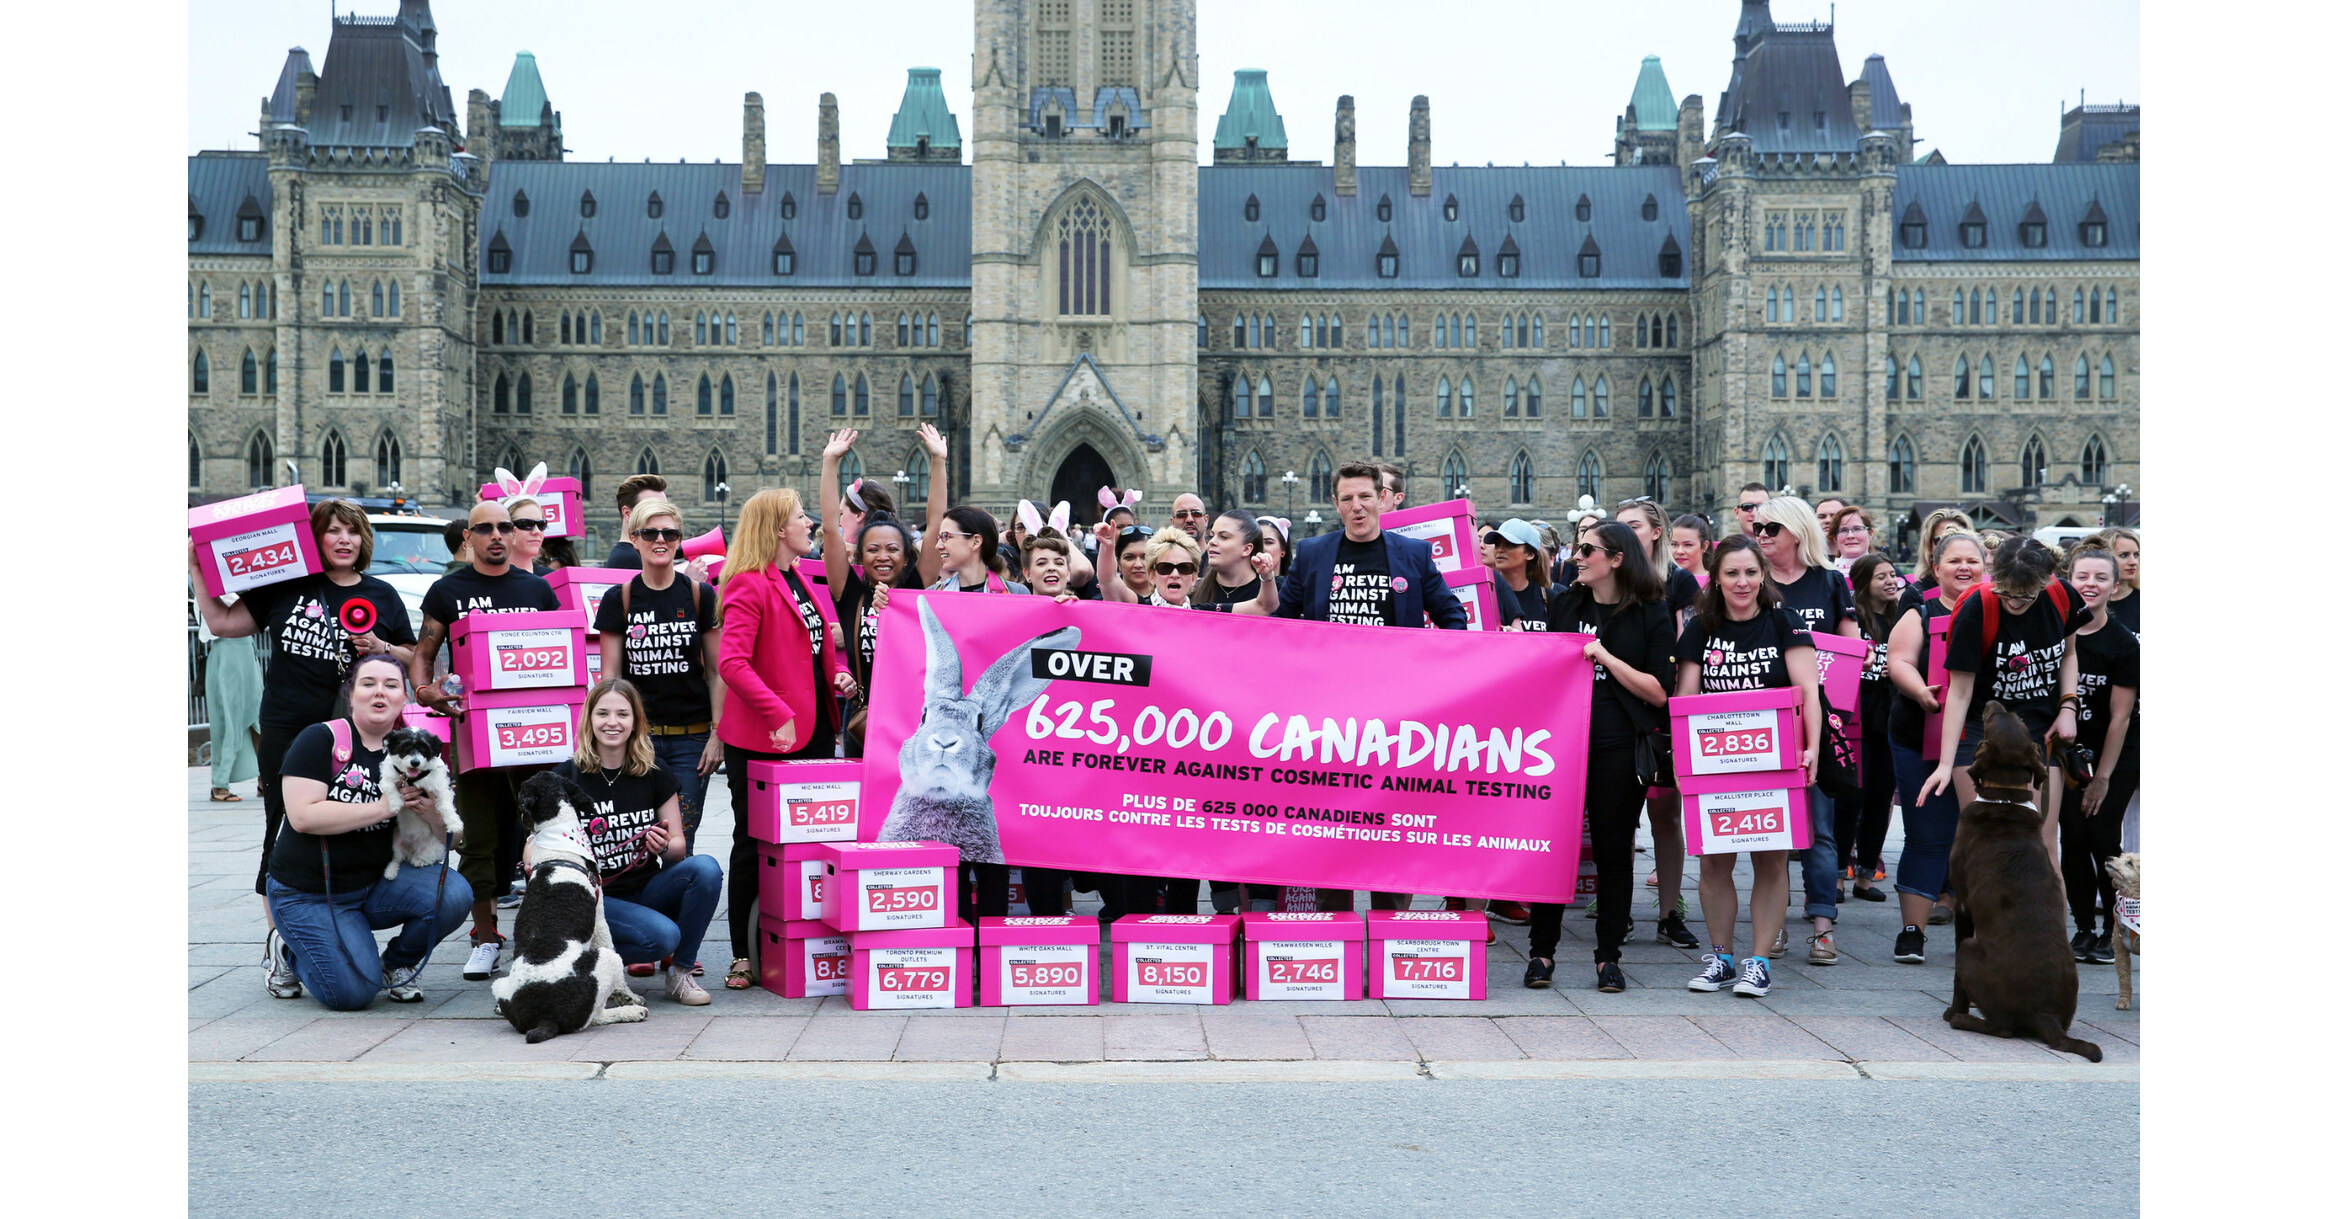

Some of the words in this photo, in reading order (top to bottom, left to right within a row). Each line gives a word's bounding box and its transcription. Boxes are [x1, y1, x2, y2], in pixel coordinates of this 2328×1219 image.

[231, 533, 261, 543] GEORGIAN
[1397, 525, 1421, 534] LAMBTON
[230, 546, 294, 573] 2,434
[1333, 564, 1355, 574] AM
[250, 569, 286, 580] SIGNATURES
[456, 600, 463, 611] I
[468, 597, 493, 609] AM
[1329, 588, 1389, 601] GAINST
[633, 611, 656, 624] AM
[1329, 602, 1379, 614] NIMAL
[625, 621, 697, 635] FREVER
[1712, 637, 1735, 652] AM
[1997, 642, 2003, 655] I
[2007, 640, 2026, 656] AM
[503, 651, 564, 670] 2,092
[1703, 647, 1779, 663] FREVER
[1047, 651, 1135, 682] OVER
[1703, 661, 1771, 677] AGAINST
[1704, 676, 1764, 690] ANIMAL
[1992, 673, 2056, 693] ANIMAL
[1707, 712, 1760, 720] CHARLOTTETOWN
[502, 728, 563, 748] 3,495
[1025, 693, 1233, 754] 625,000
[1249, 712, 1555, 776] CANADIANS
[1704, 733, 1769, 755] 2,836
[1023, 749, 1064, 766] ARE
[1072, 753, 1166, 774] FOREVER
[1173, 761, 1263, 782] AGAINST
[1270, 768, 1373, 789] COSMETIC
[1380, 776, 1457, 795] ANIMAL
[1465, 780, 1552, 800] TESTING
[580, 808, 655, 828] FREVER
[796, 805, 849, 824] 5,419
[1122, 794, 1167, 810] PLUS
[1173, 797, 1196, 812] DE
[1202, 801, 1236, 815] 625
[1242, 803, 1278, 818] 000
[1284, 806, 1385, 826] CANADIENS
[1391, 813, 1437, 829] SONT
[1019, 803, 1103, 821] TOUJOURS
[1108, 810, 1171, 827] CONTRE
[1176, 815, 1205, 829] LES
[1211, 817, 1260, 834] TESTS
[1265, 821, 1286, 835] DE
[1291, 824, 1401, 843] COSMÉTIQUES
[1406, 831, 1437, 845] SUR
[1443, 833, 1472, 847] LES
[1477, 836, 1551, 852] ANIMAUX
[1718, 813, 1777, 835] 2,416
[872, 890, 934, 912] 2,590
[817, 960, 845, 978] 8,8
[1015, 967, 1079, 986] 5,890
[1144, 966, 1201, 986] 8,150
[1273, 964, 1335, 983] 2,746
[1401, 961, 1456, 980] 7,716
[883, 972, 945, 990] 6,779
